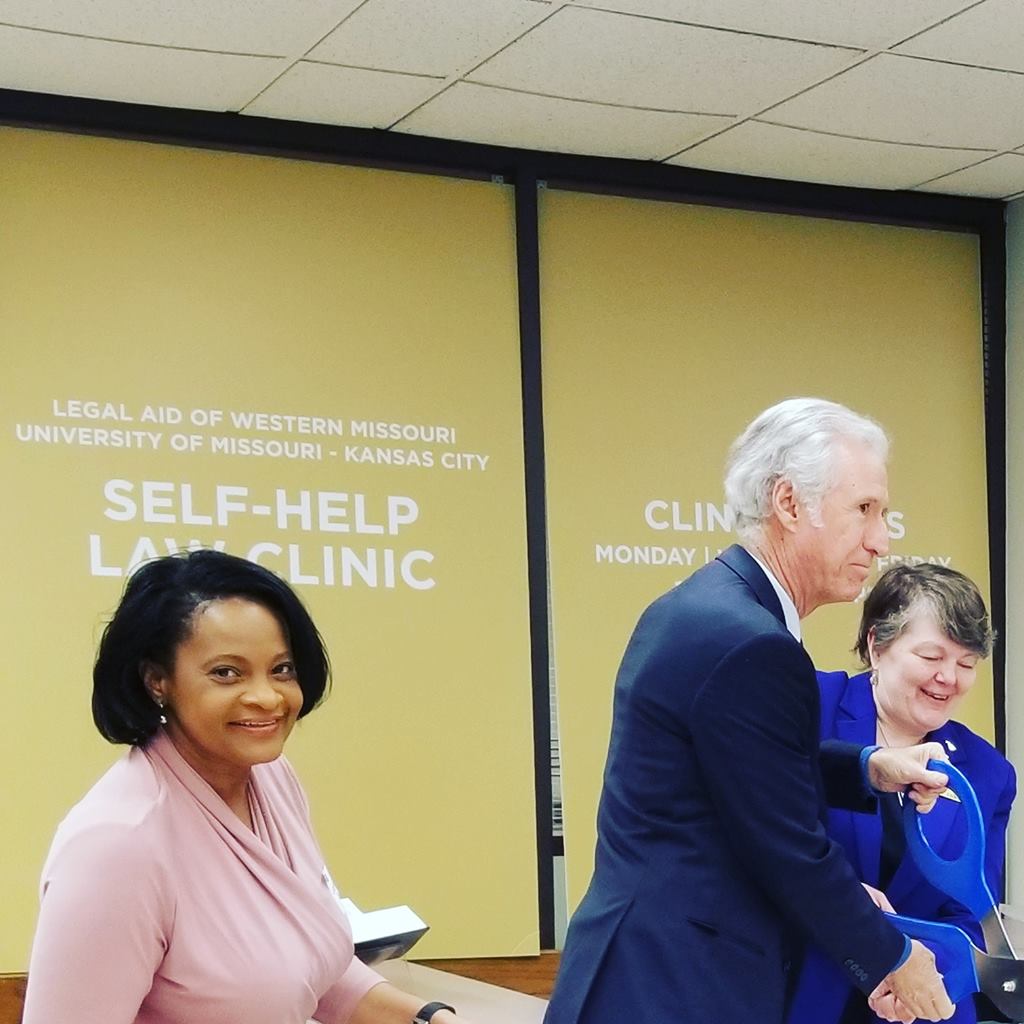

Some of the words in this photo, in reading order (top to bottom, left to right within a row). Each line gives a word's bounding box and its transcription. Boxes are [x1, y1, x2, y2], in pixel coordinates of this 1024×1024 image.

[52, 399, 132, 421] LEGAL
[140, 405, 183, 424] AID
[190, 409, 223, 427] OF
[230, 412, 343, 436] WESTERN
[351, 421, 456, 444] MISSOURI
[15, 423, 161, 449] UNIVERSITY
[172, 433, 203, 452] OF
[211, 437, 322, 460] MISSOURI
[345, 446, 434, 467] KANSAS
[441, 453, 489, 471] CITY
[103, 479, 419, 535] SELF-HELP
[644, 500, 735, 532] CLIN
[246, 542, 436, 590] CLINIC
[595, 544, 696, 566] MONDAY
